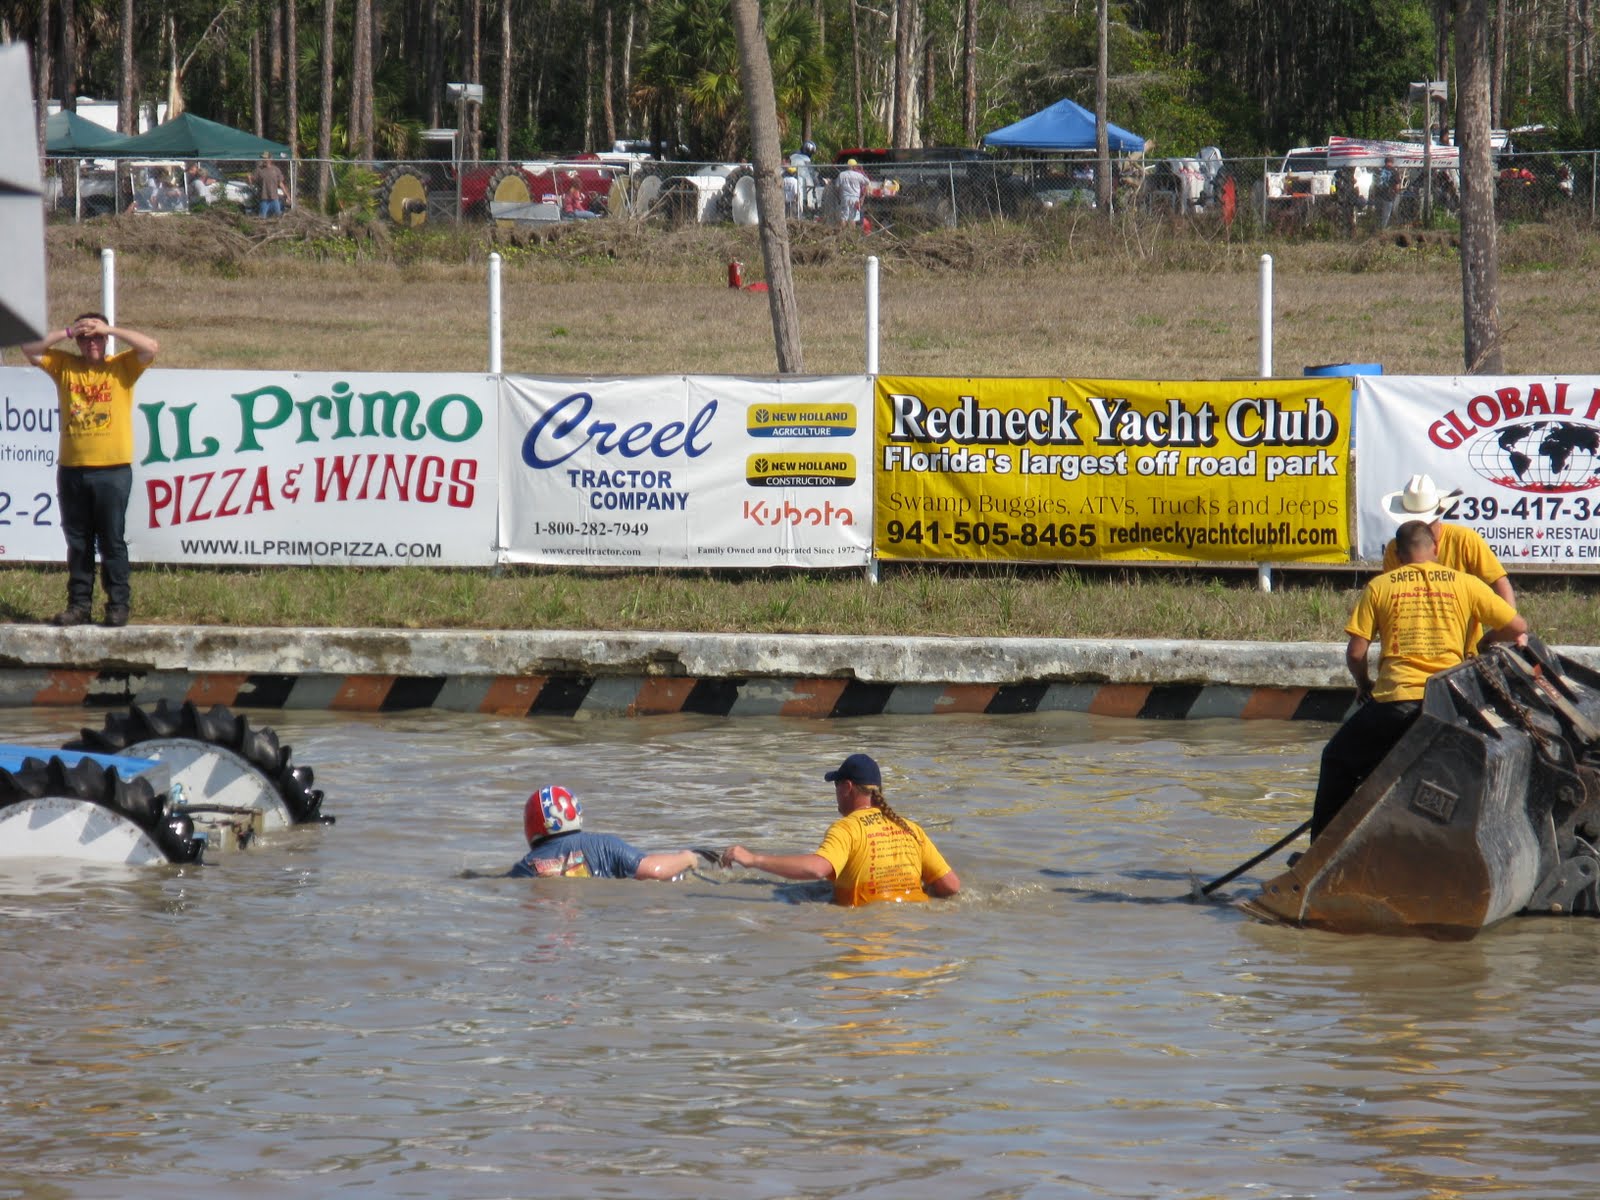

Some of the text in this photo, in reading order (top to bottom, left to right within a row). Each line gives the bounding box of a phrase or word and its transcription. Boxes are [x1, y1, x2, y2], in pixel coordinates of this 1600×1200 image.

[0, 397, 61, 432] bou
[772, 412, 848, 422] NEW HOLLAND
[888, 394, 1337, 447] Redneck Yacht Club
[1428, 383, 1574, 450] GLOBAL
[138, 400, 220, 466] IL
[521, 391, 718, 470] Creel
[772, 427, 831, 436] AGRICULTURE
[771, 462, 848, 471] NEW HOLLAND
[883, 445, 1338, 482] Florida's largest off road park
[567, 469, 672, 489] TRACTOR
[765, 477, 836, 486] CONSTRUCTION
[145, 454, 478, 529] PIZZA & WINGS
[590, 491, 690, 511] COMPANY
[743, 500, 853, 526] Kubota
[889, 492, 1339, 520] Swamp Buggies, ATVs, Trucks and Jeeps
[533, 521, 649, 537] 1-800-282-7949
[886, 520, 1338, 549] 941-505-8465 redneckyachtclubfl.com
[1473, 527, 1534, 540] GUISHER
[181, 539, 442, 559] WWW.ILPRIMOPIZZA.COM
[541, 547, 641, 557] www.creeltractor.com
[697, 546, 856, 555] Family Owned and Operated Since 1972
[1531, 545, 1561, 557] EXIT
[1565, 545, 1574, 557] &
[1390, 570, 1456, 584] SAFETY CREW
